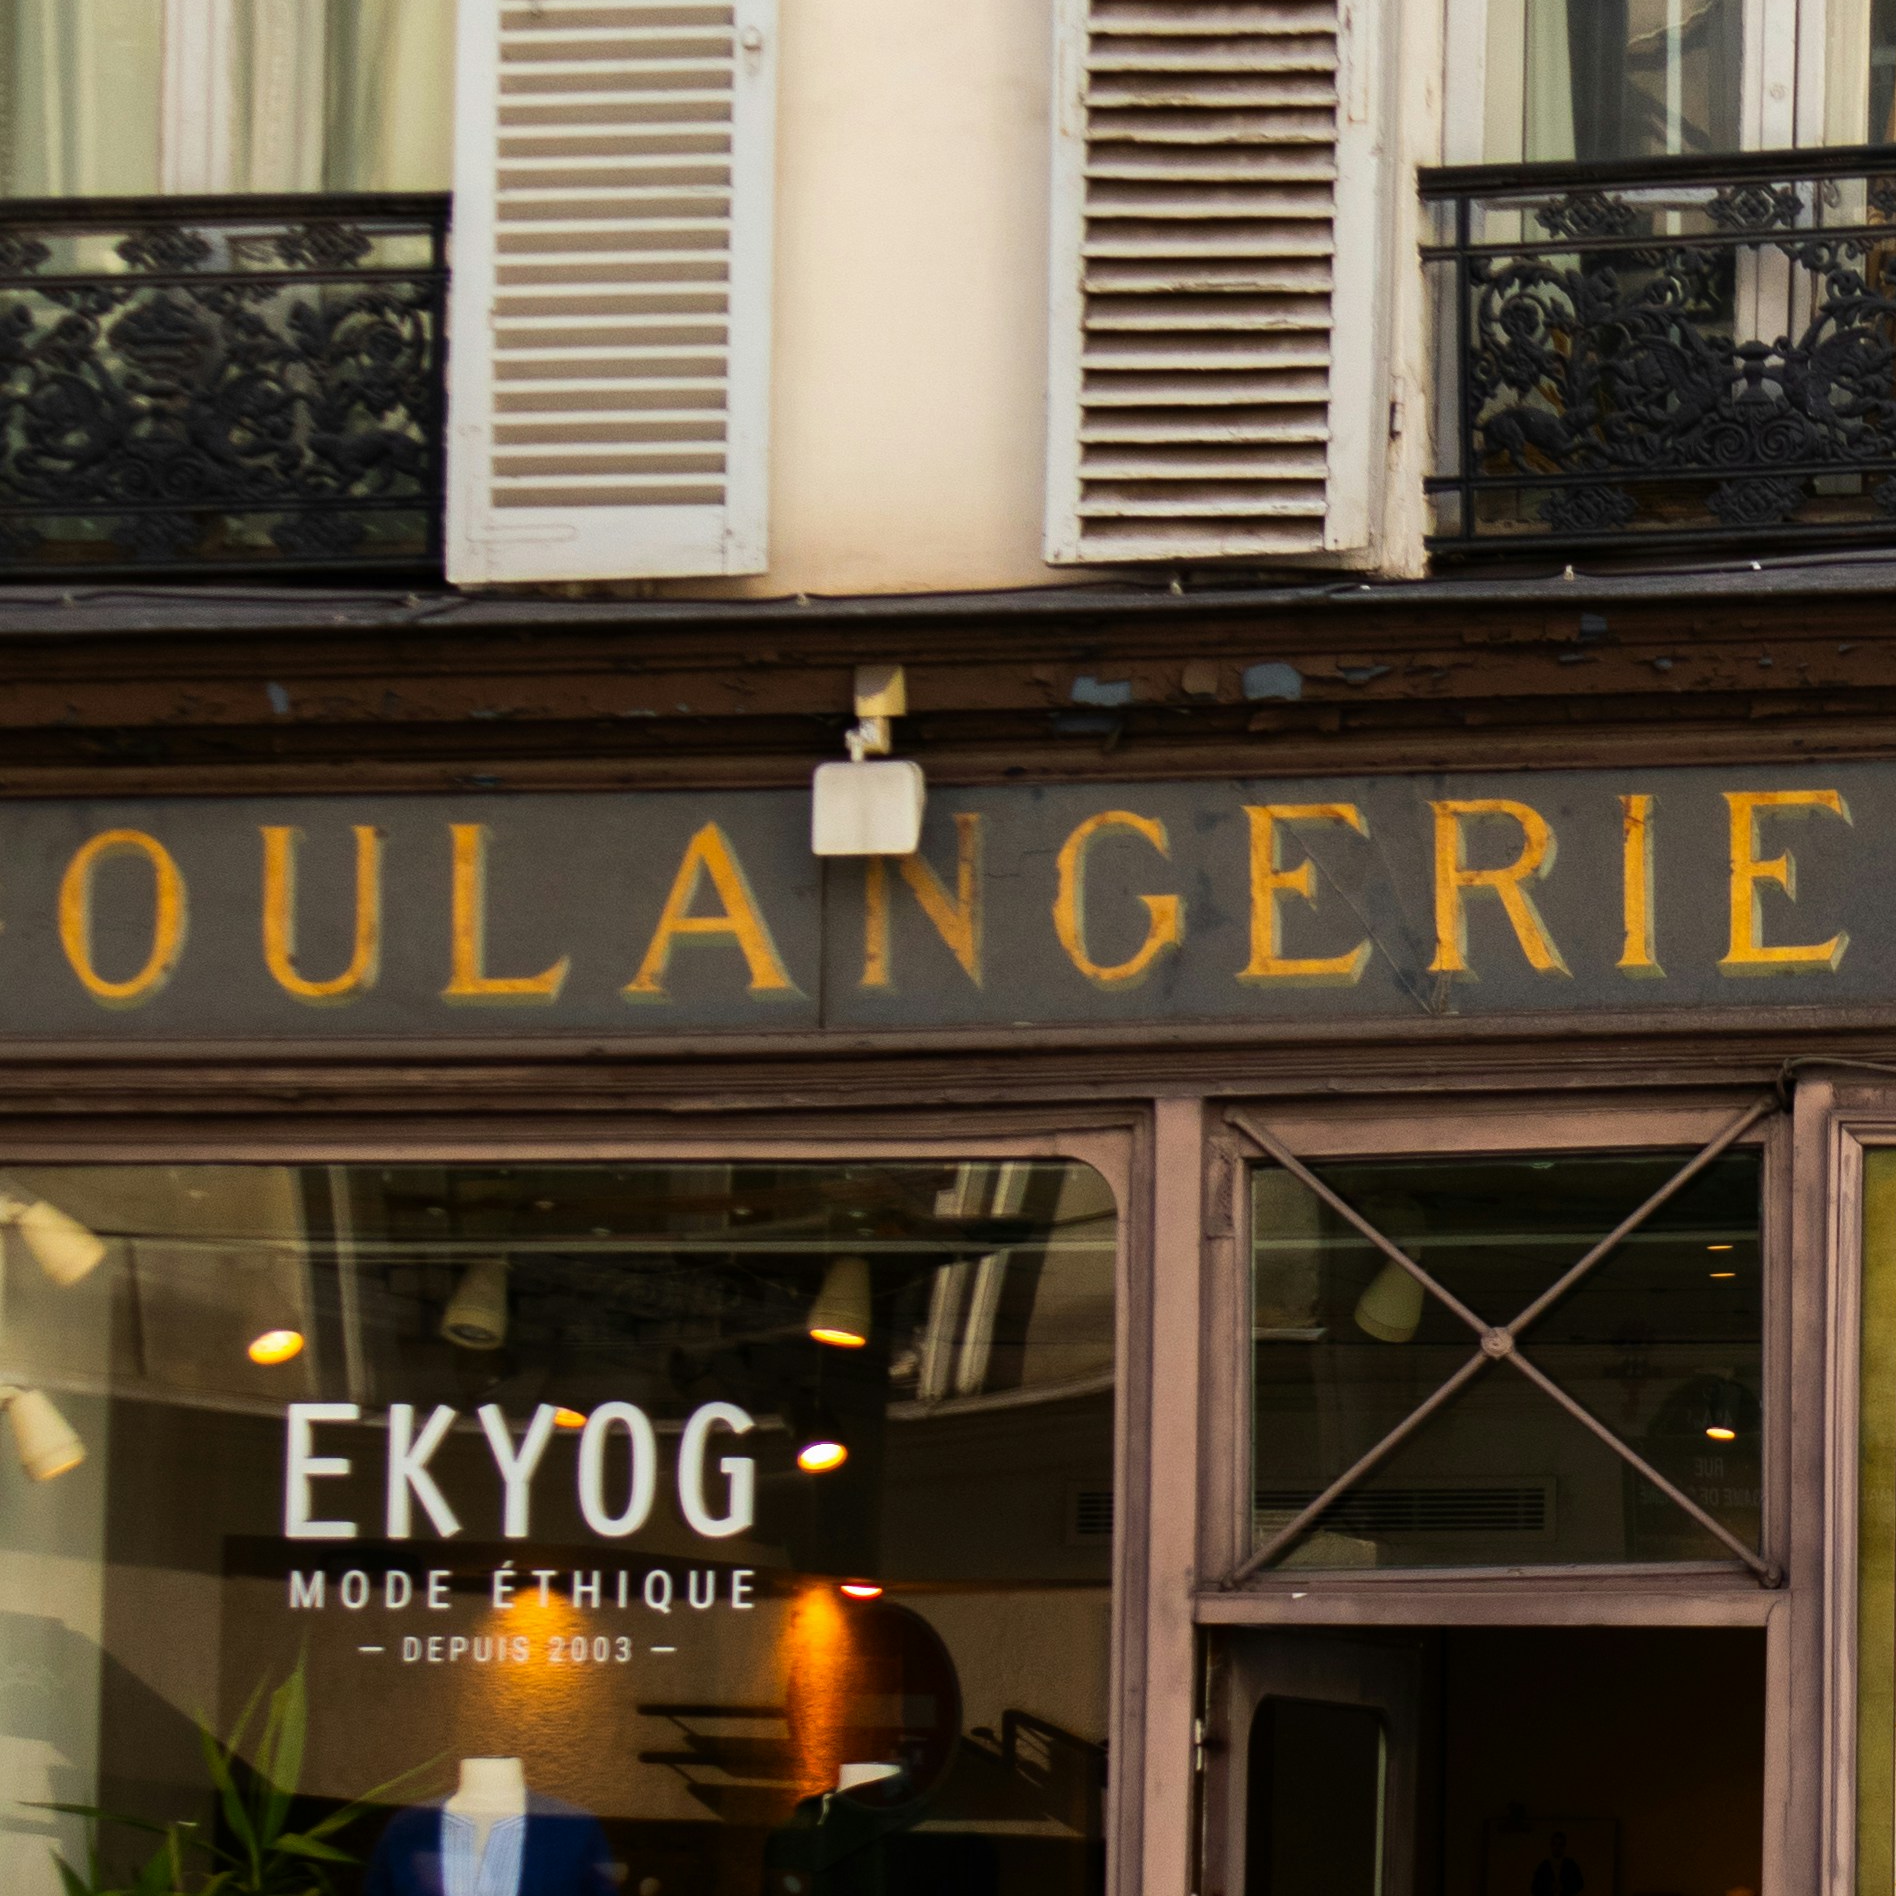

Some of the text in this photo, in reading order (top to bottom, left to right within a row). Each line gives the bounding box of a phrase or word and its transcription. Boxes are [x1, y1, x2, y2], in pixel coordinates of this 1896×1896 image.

[0, 789, 1854, 1008] OULANGERIE
[284, 1401, 757, 1539] EKYOG
[290, 1561, 756, 1614] MODE ÉTHIQUE
[403, 1635, 633, 1662] DEPUIS 2003
